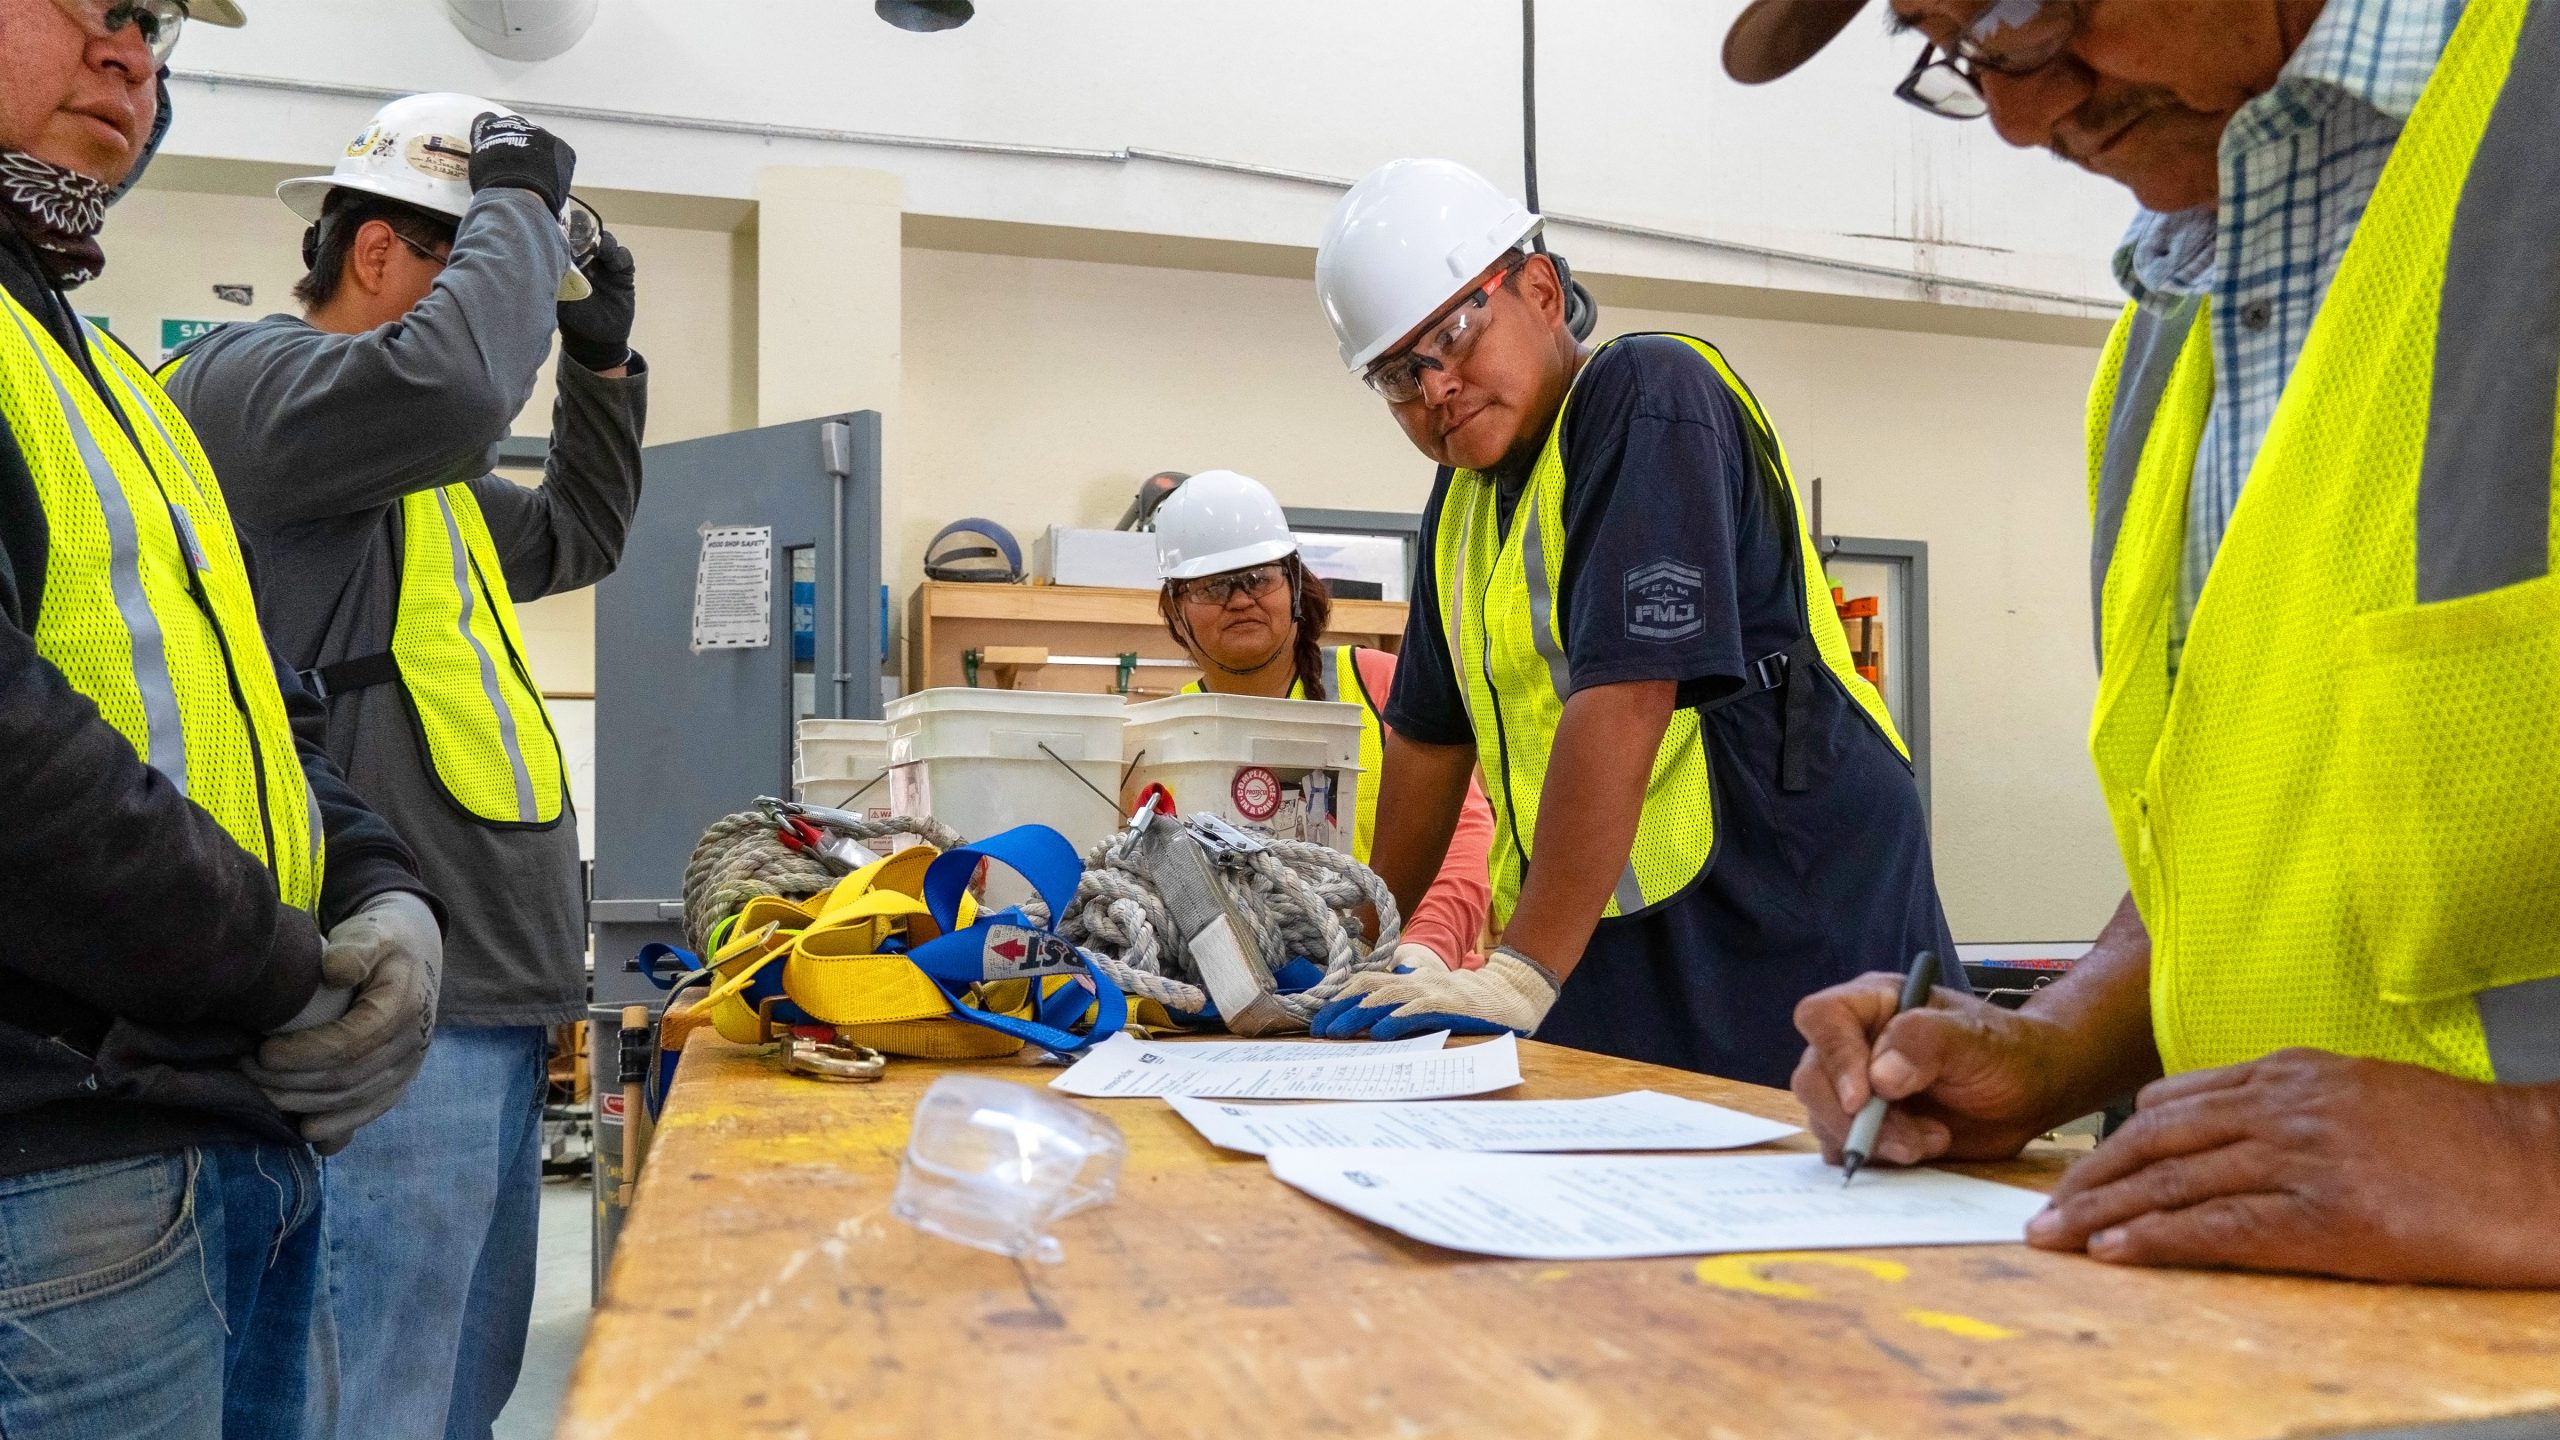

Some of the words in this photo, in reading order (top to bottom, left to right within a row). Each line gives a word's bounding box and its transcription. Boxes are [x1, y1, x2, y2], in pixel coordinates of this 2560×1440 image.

[180, 323, 220, 337] SAF
[725, 540, 741, 548] SHOP
[741, 540, 766, 548] SAFETY
[1639, 583, 1689, 597] TEAM
[1635, 603, 1695, 623] FMJ
[1237, 770, 1276, 798] COMPLIANCE
[1240, 799, 1250, 810] IN
[1249, 806, 1256, 815] A
[1257, 800, 1274, 815] CAN
